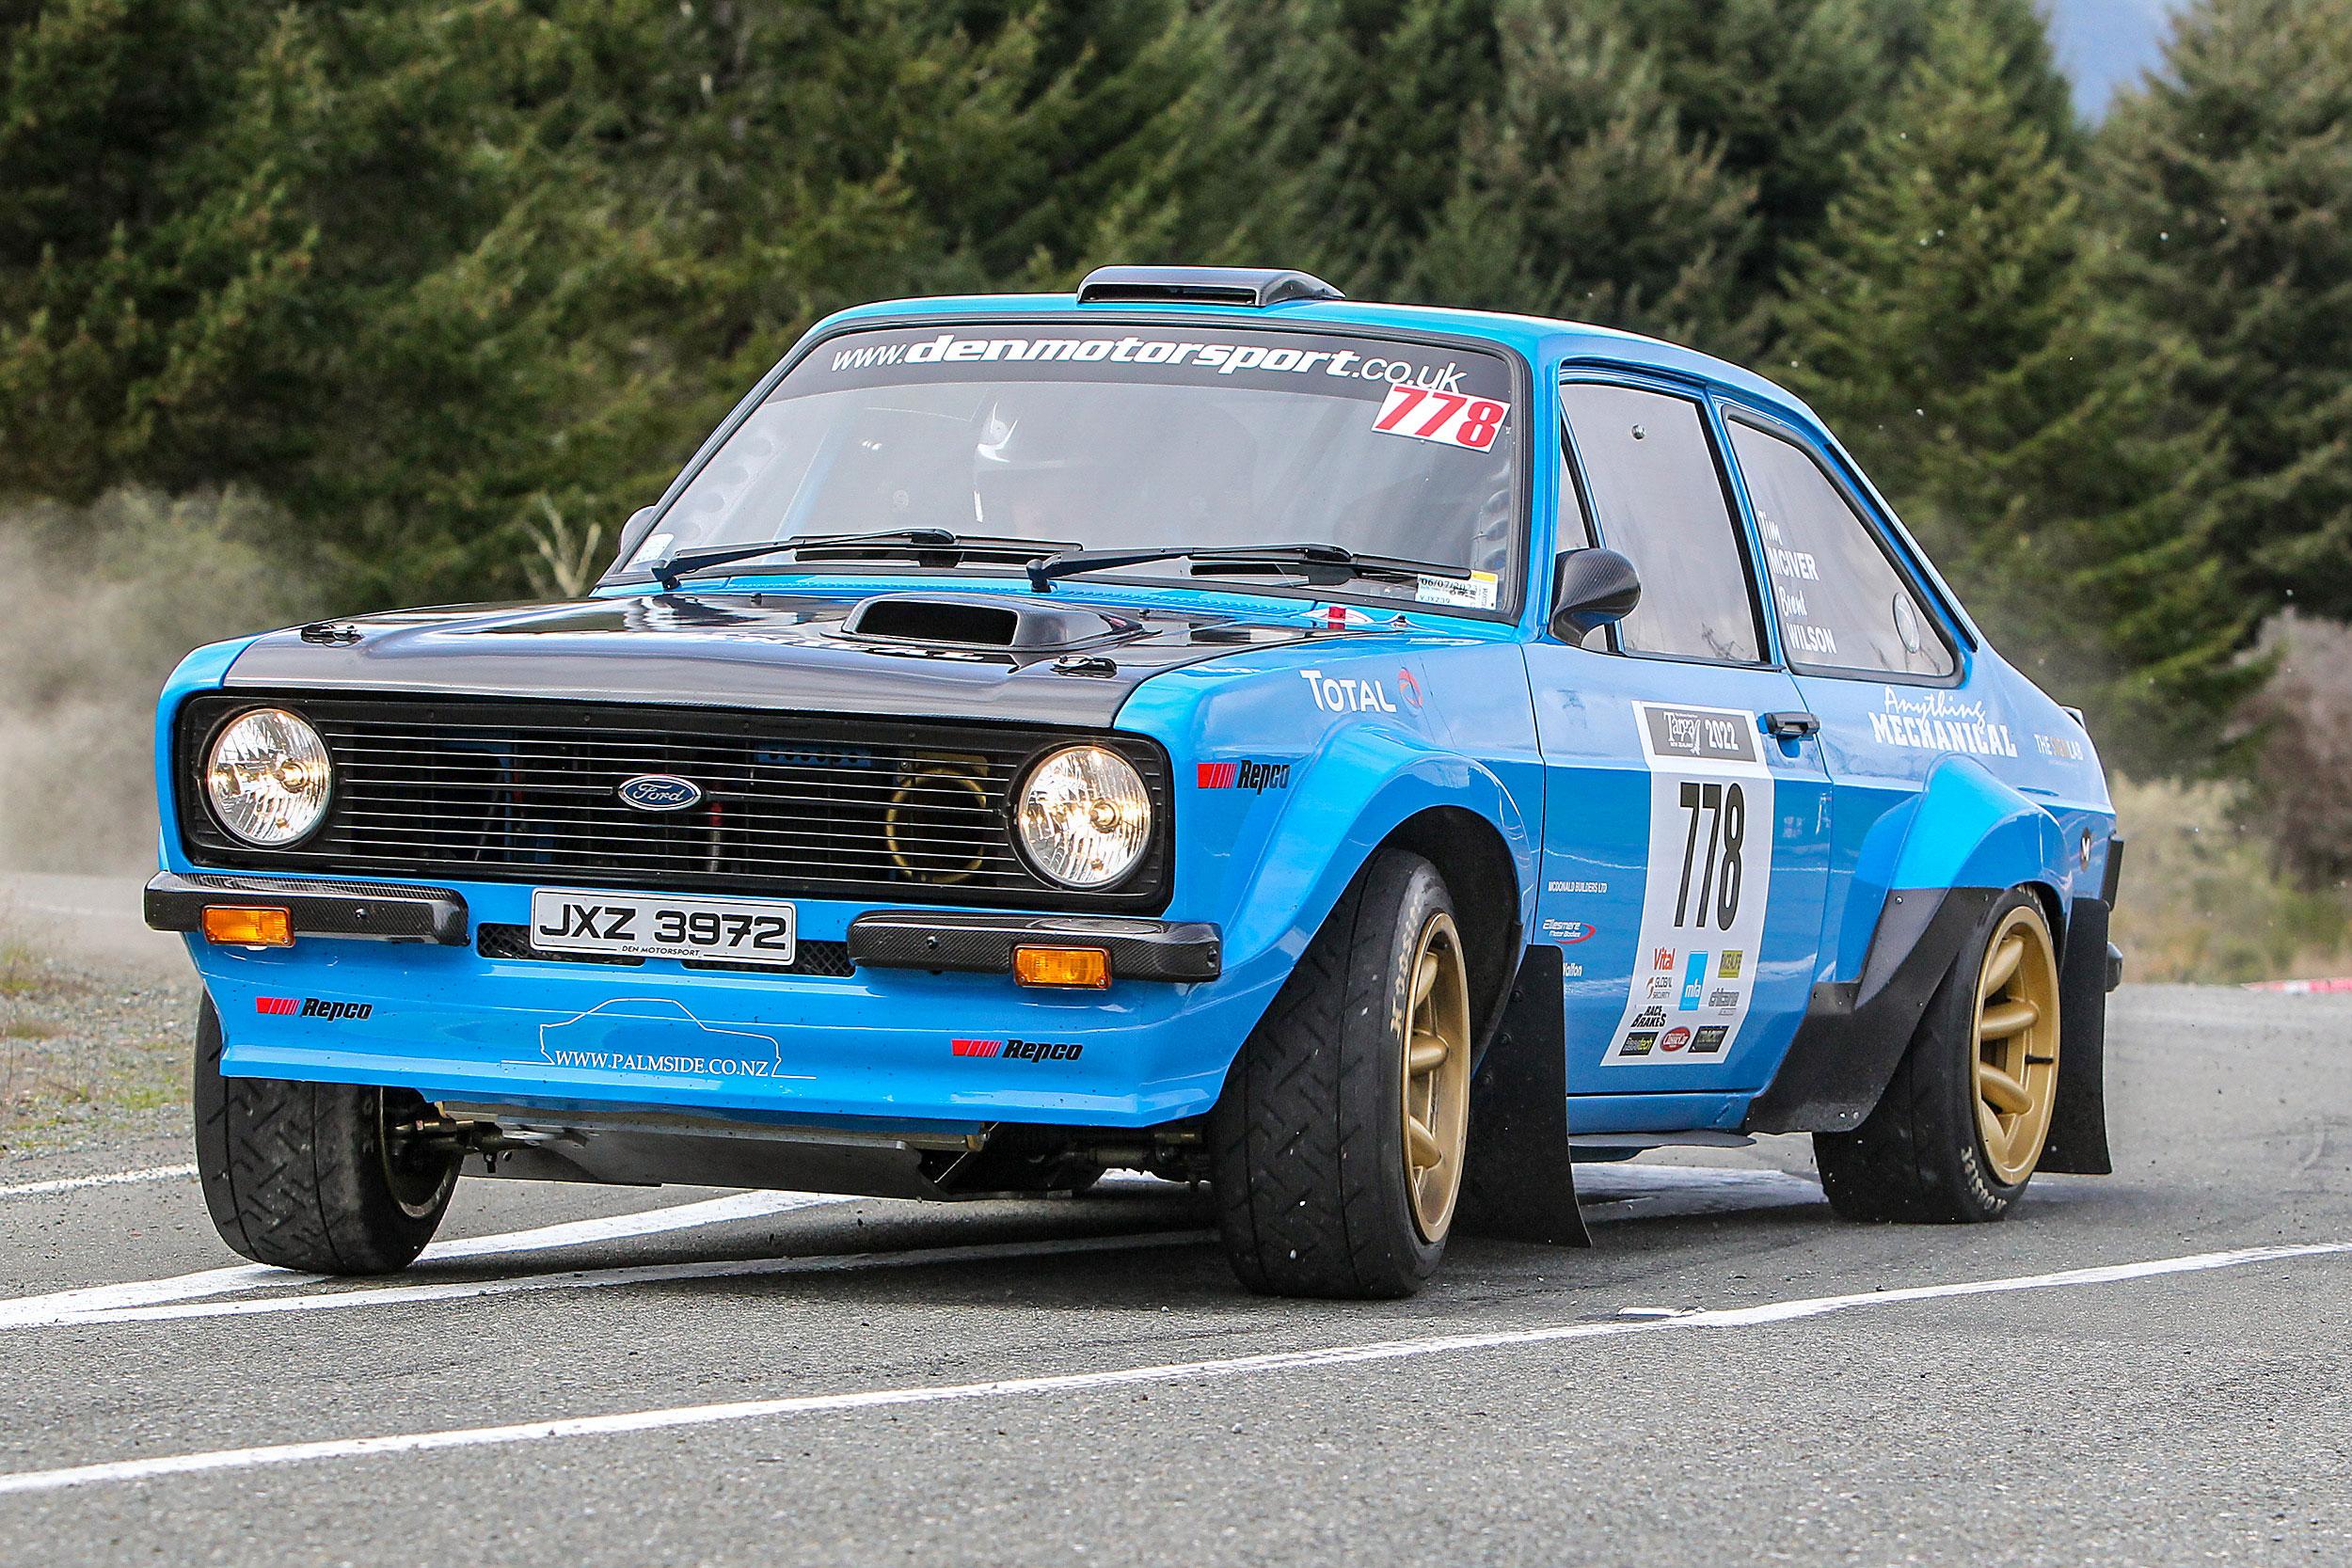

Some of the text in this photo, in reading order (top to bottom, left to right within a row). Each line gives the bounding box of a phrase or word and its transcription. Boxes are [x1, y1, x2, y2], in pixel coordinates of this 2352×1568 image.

[832, 334, 1468, 393] www.denmotorsport.co.uk
[1375, 386, 1504, 448] 778
[1778, 585, 1808, 617] Brent
[1786, 623, 1837, 654] WILSON
[1884, 685, 1985, 734] Anything
[1663, 712, 1740, 751] Targa 2022
[1867, 711, 2018, 758] MECHANICAL
[633, 783, 685, 801] Ford
[1236, 759, 1291, 795] Repco
[1674, 782, 1746, 931] 778
[540, 904, 786, 951] JXZ 3972
[641, 946, 701, 957] MOTORSPORT
[1653, 946, 1677, 971] Vital
[302, 998, 373, 1021] Repco
[1630, 1014, 1667, 1027] BRAKES
[1644, 1006, 1663, 1016] RACE
[555, 1050, 770, 1078] WWW.PALMSIDE.CO.NZ
[1002, 1038, 1083, 1063] Repco
